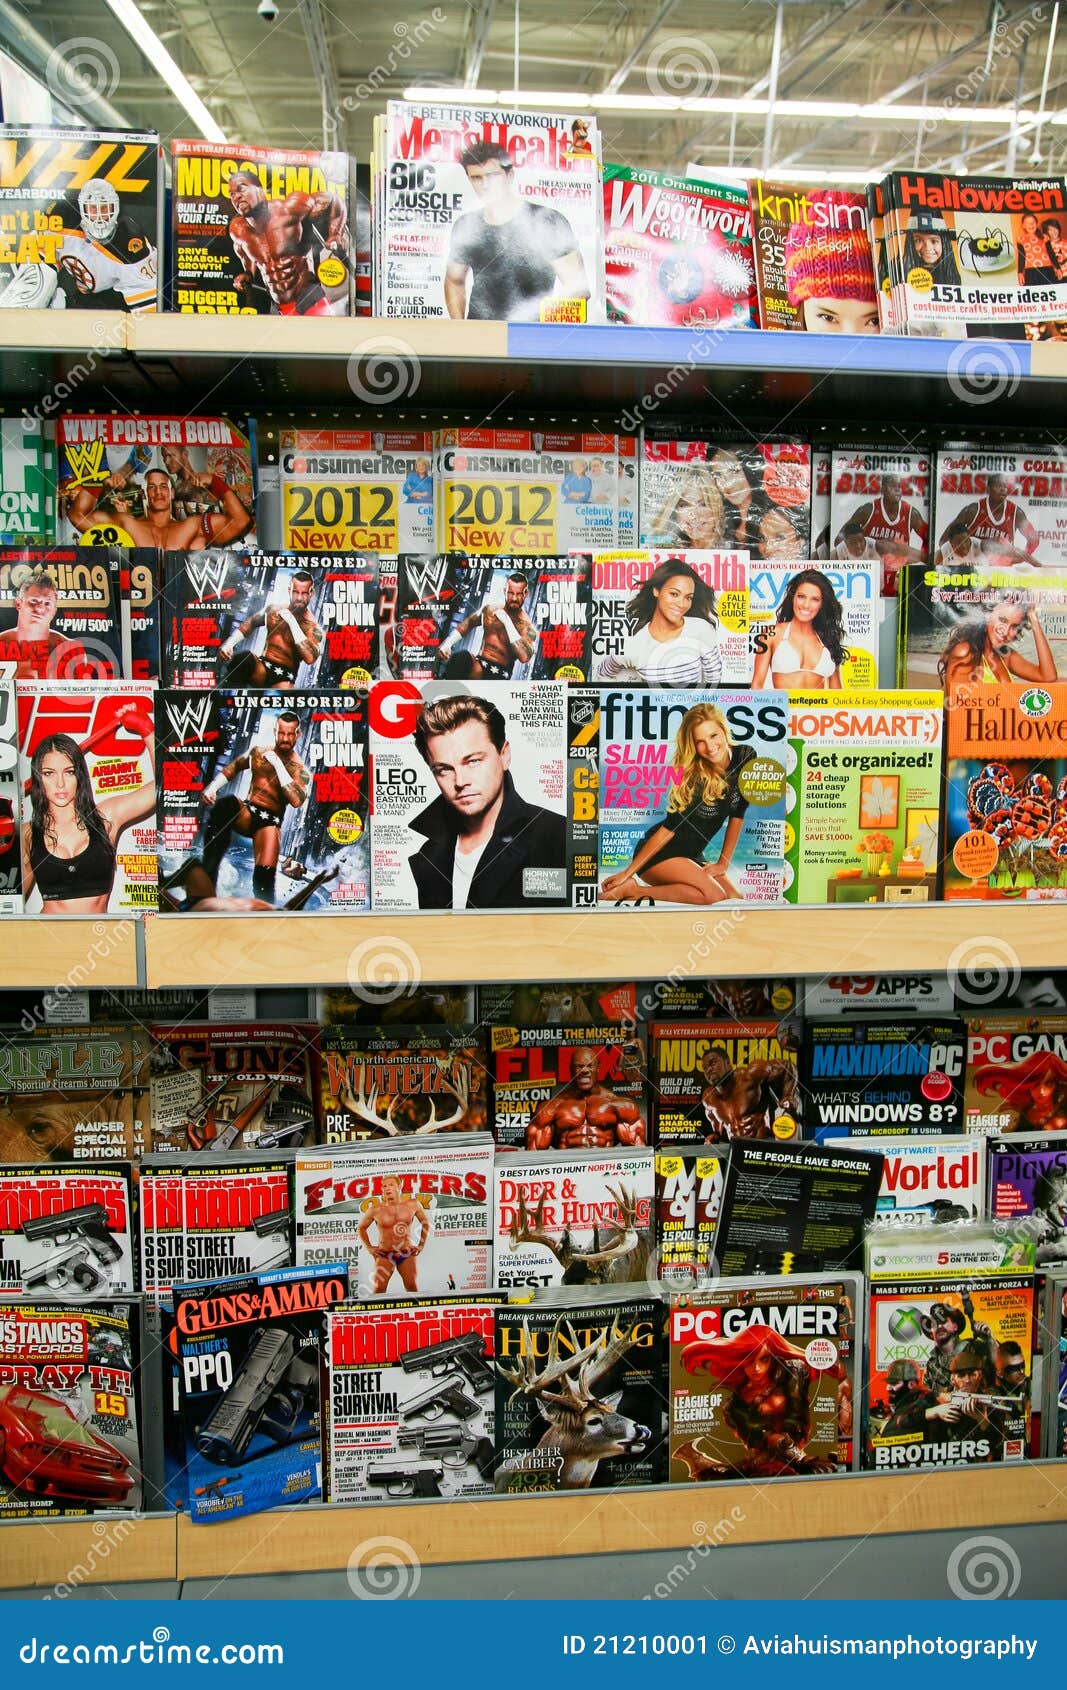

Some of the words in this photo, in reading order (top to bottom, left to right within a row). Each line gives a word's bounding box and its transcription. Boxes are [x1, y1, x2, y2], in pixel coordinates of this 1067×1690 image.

[421, 107, 471, 122] BETTER
[474, 111, 499, 124] SEX
[503, 113, 566, 129] WORKOUT
[390, 163, 435, 192] BIG
[663, 177, 723, 198] Ornament
[1013, 180, 1060, 191] FamilyFun
[901, 176, 1064, 211] Halloween
[178, 203, 205, 215] BUILD
[206, 205, 219, 215] UP
[390, 193, 462, 210] MUSCLE
[178, 214, 201, 225] YOUR
[203, 215, 228, 225] PECS
[650, 220, 709, 244] CRAFTS
[178, 248, 208, 256] DRIVE
[178, 255, 230, 263] ANABOLIC
[762, 245, 785, 265] 35
[178, 263, 222, 271] GROWTH
[178, 291, 238, 306] BIGGER
[931, 286, 964, 303] 151
[968, 290, 1013, 304] clever
[1017, 289, 1057, 303] ideas
[400, 306, 443, 315] BUILDING
[63, 419, 108, 443] WWE
[113, 419, 182, 443] POSTER
[185, 420, 232, 444] BOOK
[865, 455, 912, 473] SPORTS
[971, 453, 1016, 473] SPORTS
[288, 485, 396, 528] 2012
[449, 484, 554, 526] 2012
[90, 527, 118, 546] 20
[290, 528, 345, 550] New
[350, 529, 395, 549] Car
[449, 527, 506, 548] New
[510, 527, 552, 548] Car
[251, 556, 367, 568] UNCENSORED
[468, 558, 579, 569] UNCENSORED
[333, 581, 364, 603] CM
[546, 581, 577, 603] CM
[727, 594, 746, 602] FALL
[721, 609, 746, 618] GUIDE
[722, 602, 746, 610] STYLE
[322, 602, 375, 626] PUNK
[537, 602, 587, 626] PUNK
[234, 697, 356, 708] UNCENSORED
[320, 721, 353, 744] CM
[310, 744, 364, 767] PUNK
[604, 744, 668, 764] SLIM
[806, 752, 838, 768] Get
[841, 752, 933, 771] organized!
[752, 763, 767, 772] Get
[376, 769, 417, 785] LEO
[604, 766, 684, 787] DOWN
[741, 772, 761, 780] GYM
[761, 772, 785, 781] BODY
[806, 771, 822, 782] 24
[823, 774, 850, 784] cheap
[756, 782, 781, 791] HOME
[824, 784, 846, 793] easy
[604, 788, 667, 808] FAST
[805, 792, 840, 801] storage
[805, 801, 847, 809] solutions
[963, 836, 986, 848] 101
[876, 974, 934, 996] APPS
[521, 1029, 563, 1041] DOUBLE
[967, 1036, 1007, 1065] PC
[53, 1078, 87, 1088] Firearms
[90, 1077, 120, 1088] Journal
[495, 1090, 530, 1101] PACK
[532, 1089, 550, 1100] ON
[863, 1090, 912, 1103] BEHIND
[495, 1101, 538, 1113] FREAKY
[818, 1104, 923, 1124] WINDOWS
[929, 1104, 958, 1123] 8?
[74, 1122, 125, 1132] MAUSER
[326, 1115, 354, 1132] PRE-
[495, 1113, 531, 1128] SIZE
[74, 1134, 126, 1145] SPECIAL
[73, 1147, 127, 1158] EDITION!
[743, 1150, 763, 1160] THE
[764, 1152, 803, 1164] PEOPLE
[803, 1157, 830, 1167] HAVE
[831, 1158, 871, 1171] SPOKEN.
[507, 1169, 528, 1177] BEST
[529, 1168, 550, 1176] DAYS
[552, 1167, 562, 1175] TO
[563, 1166, 587, 1174] HUNT
[588, 1163, 615, 1171] NORTH
[623, 1161, 651, 1169] SOUTH
[304, 1220, 343, 1231] POWER
[304, 1227, 358, 1235] PERSONALITY
[443, 1221, 487, 1229] REFEREE
[663, 1222, 683, 1231] GAIN
[187, 1236, 235, 1257] STREET
[499, 1270, 514, 1278] Get
[998, 1281, 1021, 1289] FORZA
[622, 1304, 654, 1314] DECLINE?
[332, 1310, 438, 1325] CONCEALED
[673, 1311, 717, 1341] PC
[723, 1305, 838, 1338] GAMER
[28, 1344, 83, 1353] FORDS
[183, 1351, 233, 1394] PPQ
[88, 1367, 132, 1396] IT!
[333, 1372, 382, 1394] STREET
[95, 1392, 127, 1417] 15
[333, 1393, 399, 1417] SURVIVAL
[674, 1395, 710, 1409] LEAGUE
[674, 1407, 714, 1422] LEGENDS
[876, 1440, 990, 1464] BROTHERS
